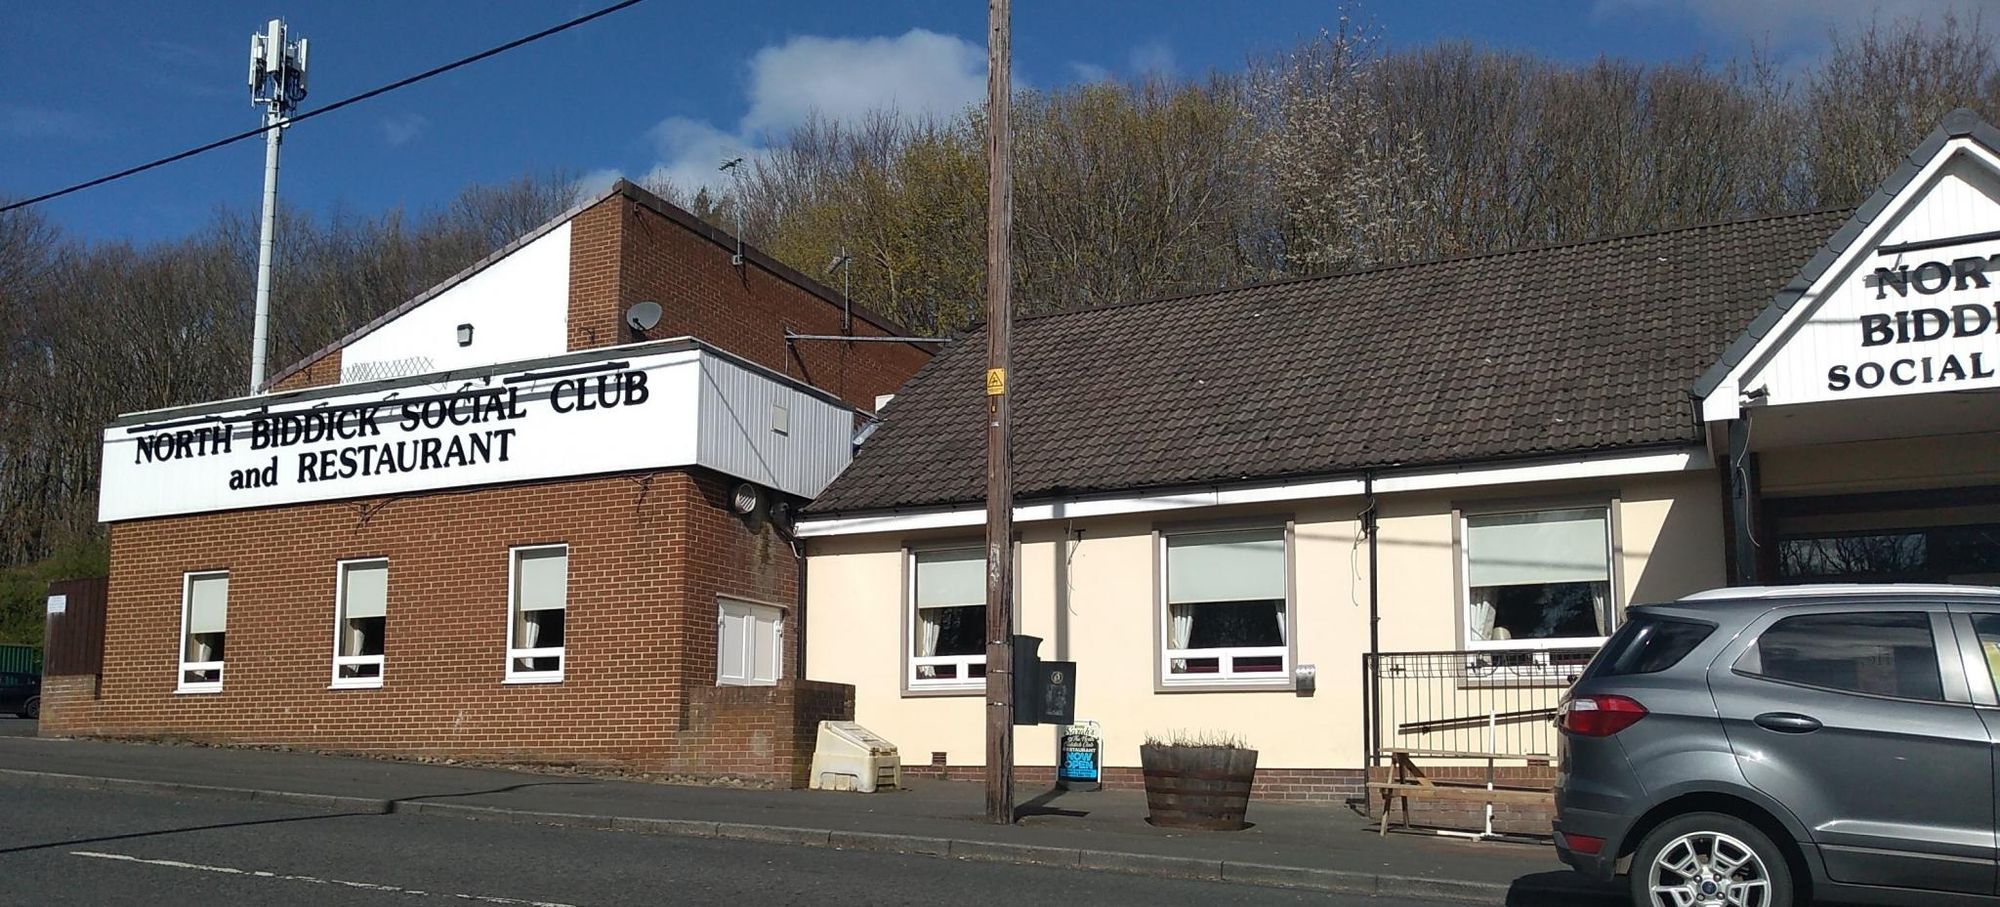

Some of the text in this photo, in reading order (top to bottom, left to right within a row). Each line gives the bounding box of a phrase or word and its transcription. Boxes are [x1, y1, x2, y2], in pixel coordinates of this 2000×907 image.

[1828, 352, 1995, 391] SOCIAL
[135, 370, 649, 464] NORTH BIDDICK SOCIAL CLUB
[229, 428, 516, 491] and RESTAURANT
[1064, 760, 1094, 769] OPEN
[1066, 752, 1093, 761] NOW
